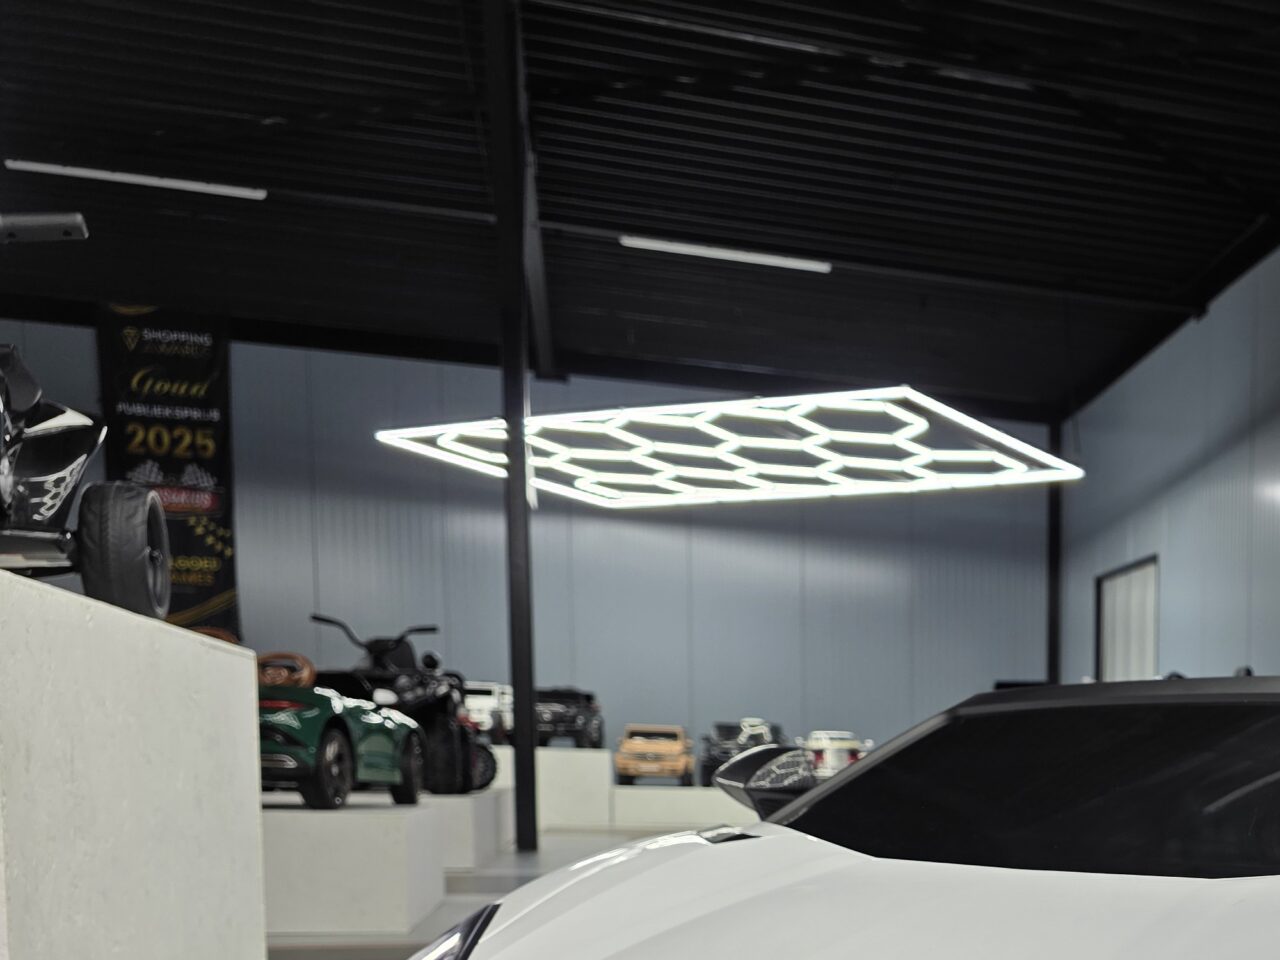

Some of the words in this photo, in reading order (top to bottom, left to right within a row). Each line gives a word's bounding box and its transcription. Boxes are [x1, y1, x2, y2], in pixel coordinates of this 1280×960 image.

[142, 328, 212, 347] SHOPPING
[131, 367, 212, 398] Goud
[127, 424, 216, 459] 2025
